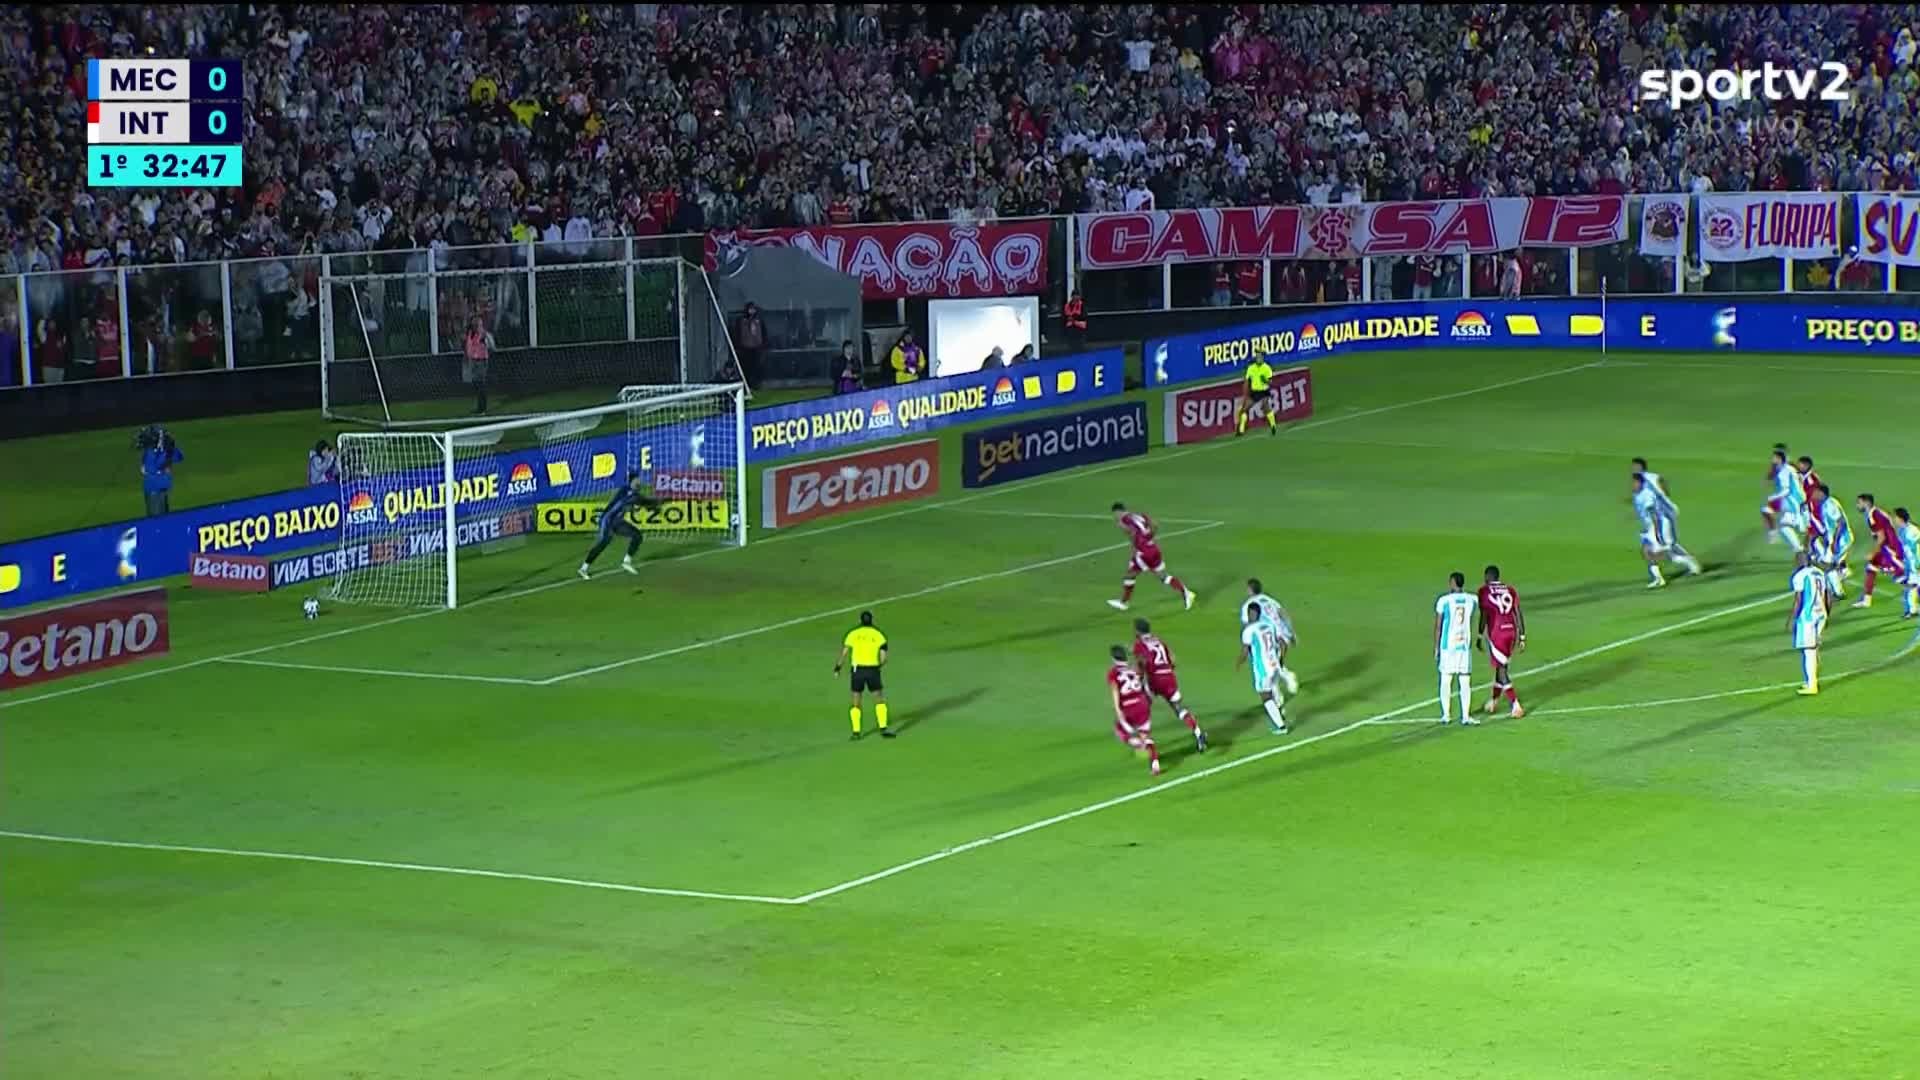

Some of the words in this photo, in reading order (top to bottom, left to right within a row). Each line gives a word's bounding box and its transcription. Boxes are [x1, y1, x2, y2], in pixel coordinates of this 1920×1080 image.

[1087, 207, 1302, 267] CAM
[1362, 200, 1499, 254] SA
[1521, 197, 1622, 244] 12
[1744, 201, 1839, 250] FLORIPA
[1865, 200, 1920, 257] SU
[1203, 339, 1248, 367] PREÇO
[1250, 330, 1295, 358] BAIXO
[1323, 315, 1440, 351] QUALIDADE
[1806, 319, 1895, 346] PREÇO
[1899, 320, 1920, 343] B
[898, 386, 987, 428] QUALIDADE
[752, 419, 809, 450] PREÇO
[812, 407, 864, 440] BAIXO
[655, 474, 723, 495] Betano
[787, 459, 930, 514] Betano
[198, 515, 270, 552] PREÇO
[273, 501, 340, 538] BAIXO
[193, 557, 266, 580] Betano
[274, 561, 310, 585] VIVA
[313, 544, 369, 576] SORTE
[409, 528, 444, 556] VIVA
[454, 517, 500, 546] ORTE
[1489, 593, 1513, 615] 49
[0, 613, 157, 677] etano
[1151, 645, 1168, 665] 21
